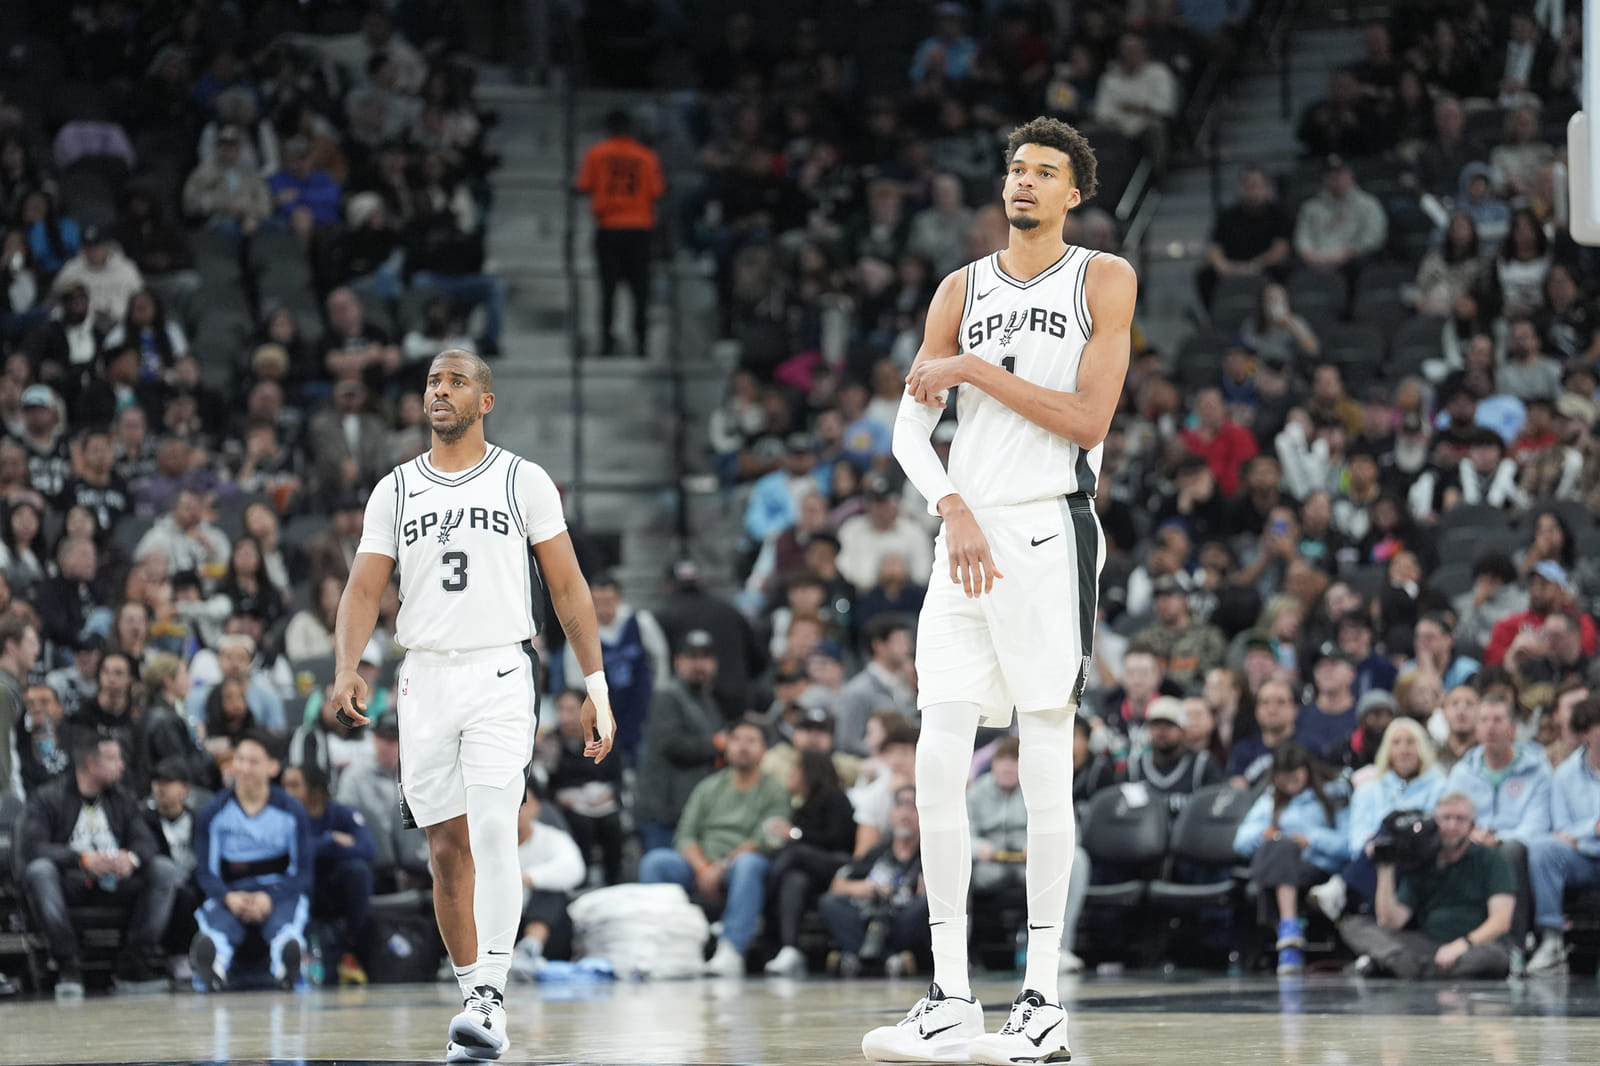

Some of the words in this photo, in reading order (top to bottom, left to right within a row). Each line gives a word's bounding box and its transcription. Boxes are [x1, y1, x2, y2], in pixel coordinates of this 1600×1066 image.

[967, 307, 1067, 349] SPURS
[403, 507, 509, 547] SPURS
[441, 551, 468, 592] 3
